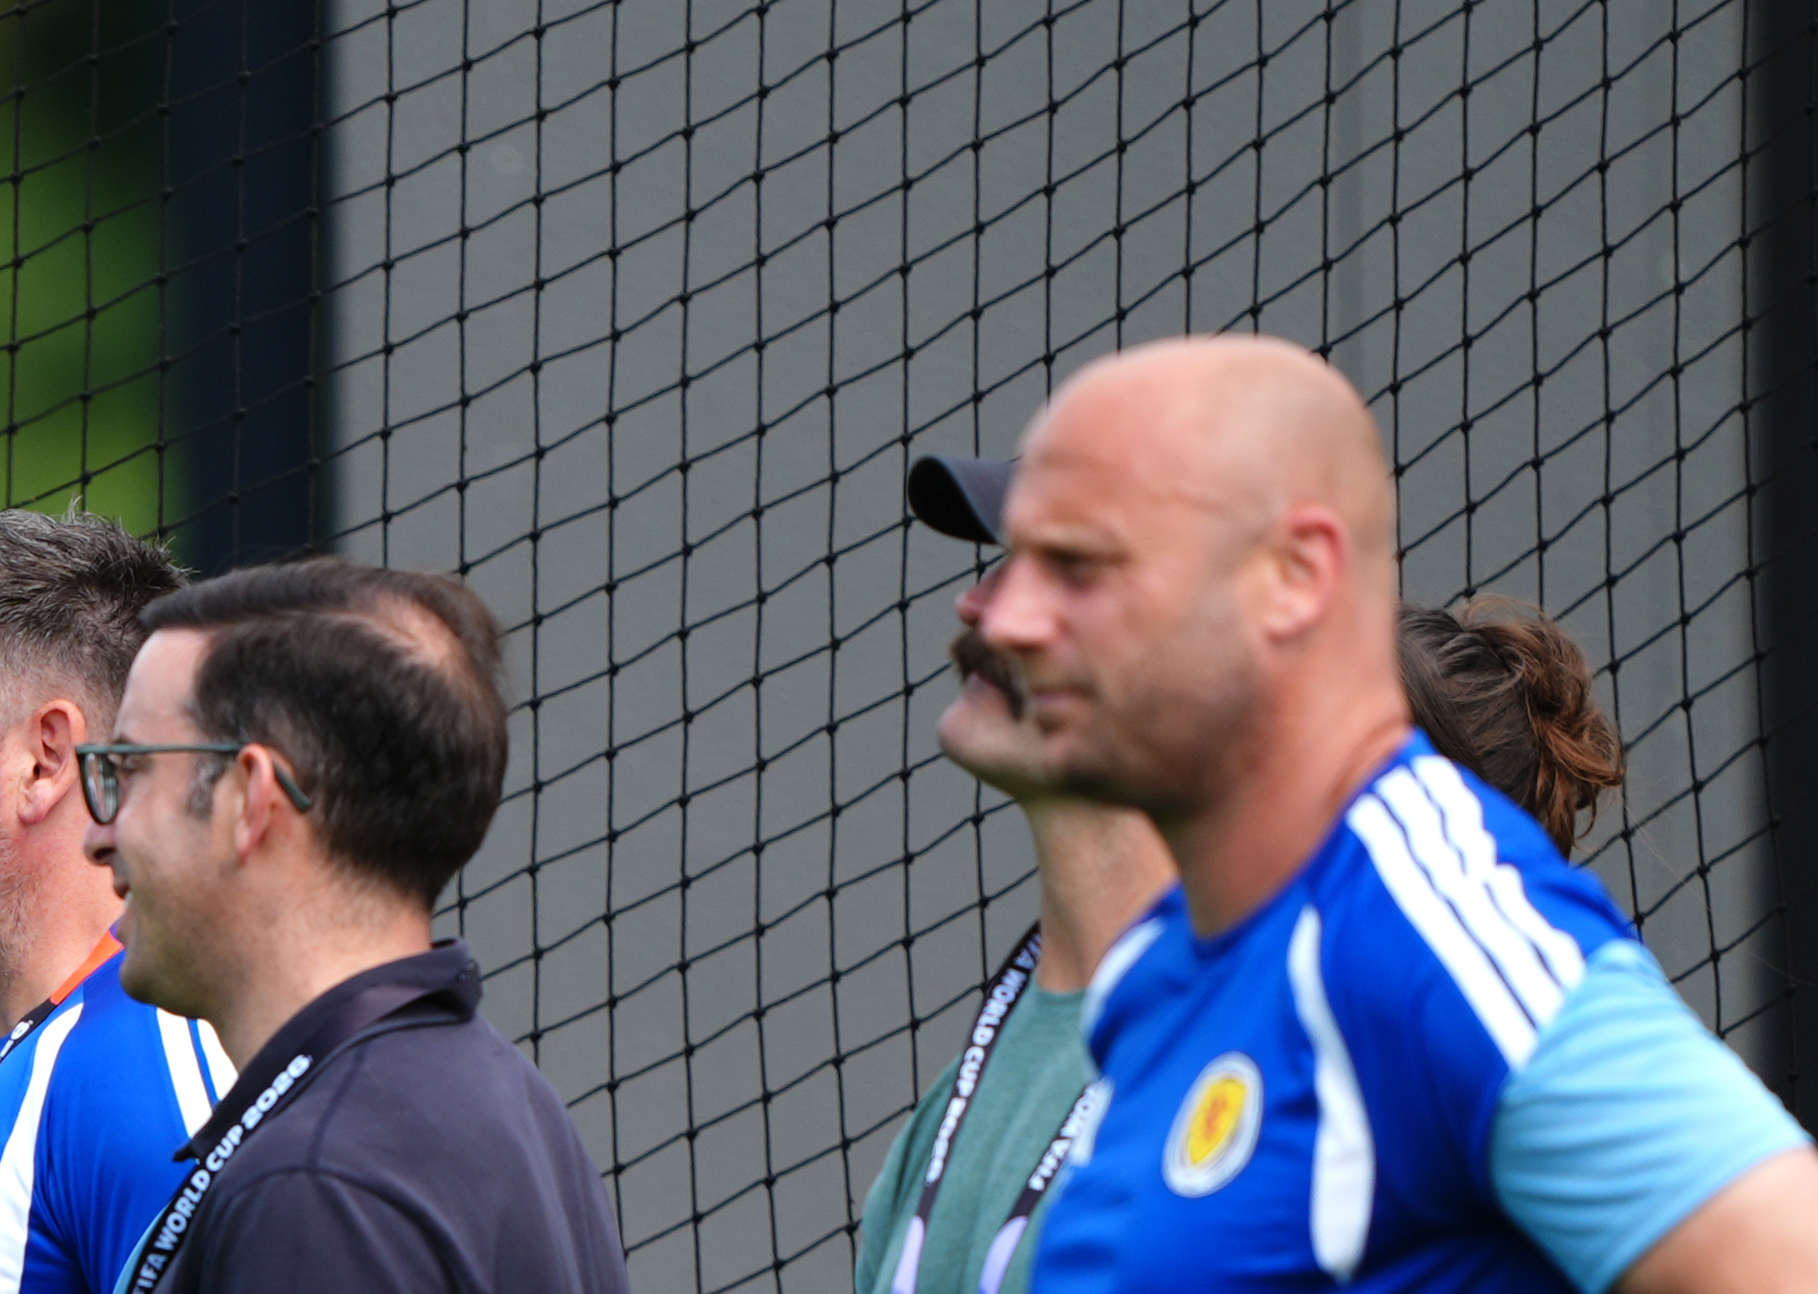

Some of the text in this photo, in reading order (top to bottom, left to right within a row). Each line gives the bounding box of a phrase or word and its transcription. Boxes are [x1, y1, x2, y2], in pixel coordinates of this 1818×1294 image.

[972, 967, 1027, 1047] WORLD
[956, 1046, 985, 1098] CUP
[154, 1169, 211, 1251] WORLD
[206, 1124, 243, 1172] CUP
[241, 1054, 312, 1130] 2026
